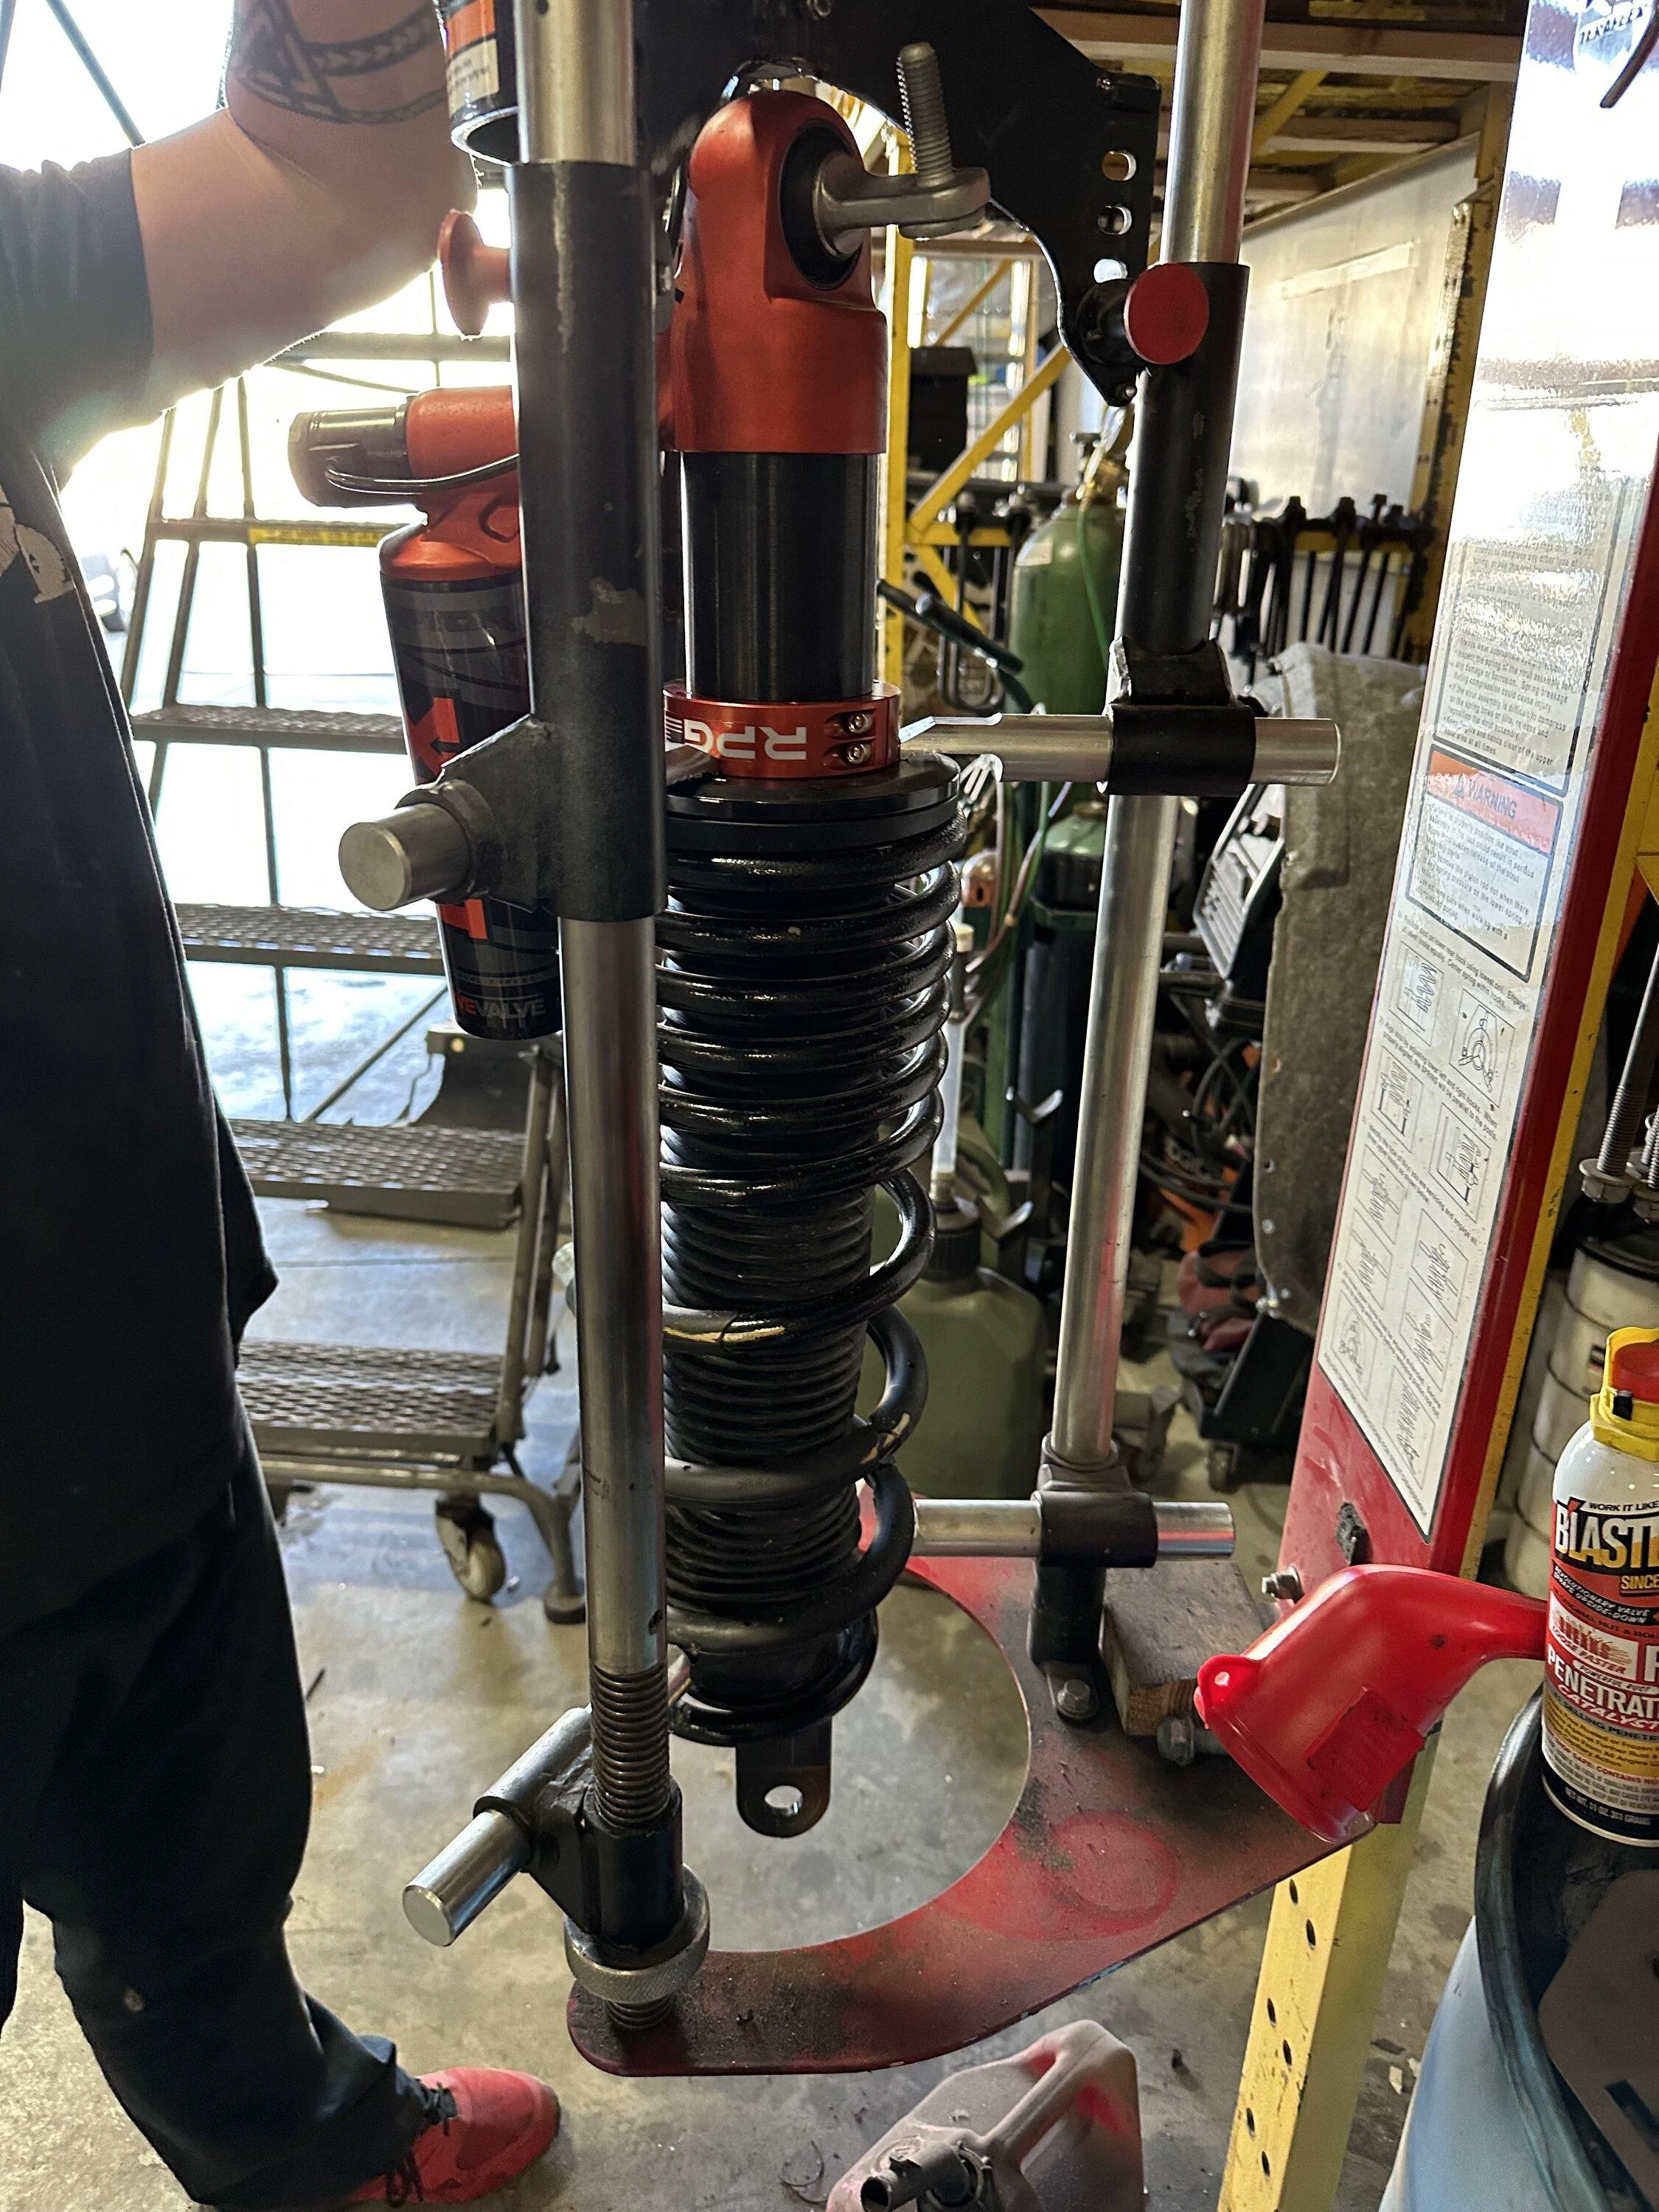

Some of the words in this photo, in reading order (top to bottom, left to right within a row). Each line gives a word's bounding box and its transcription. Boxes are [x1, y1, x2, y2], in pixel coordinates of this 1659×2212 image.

[684, 718, 807, 761] RPG
[1467, 779, 1517, 820] WARNING
[1589, 1502, 1620, 1512] WORK
[1623, 1503, 1632, 1512] IT
[1579, 1649, 1627, 1674] FASTER
